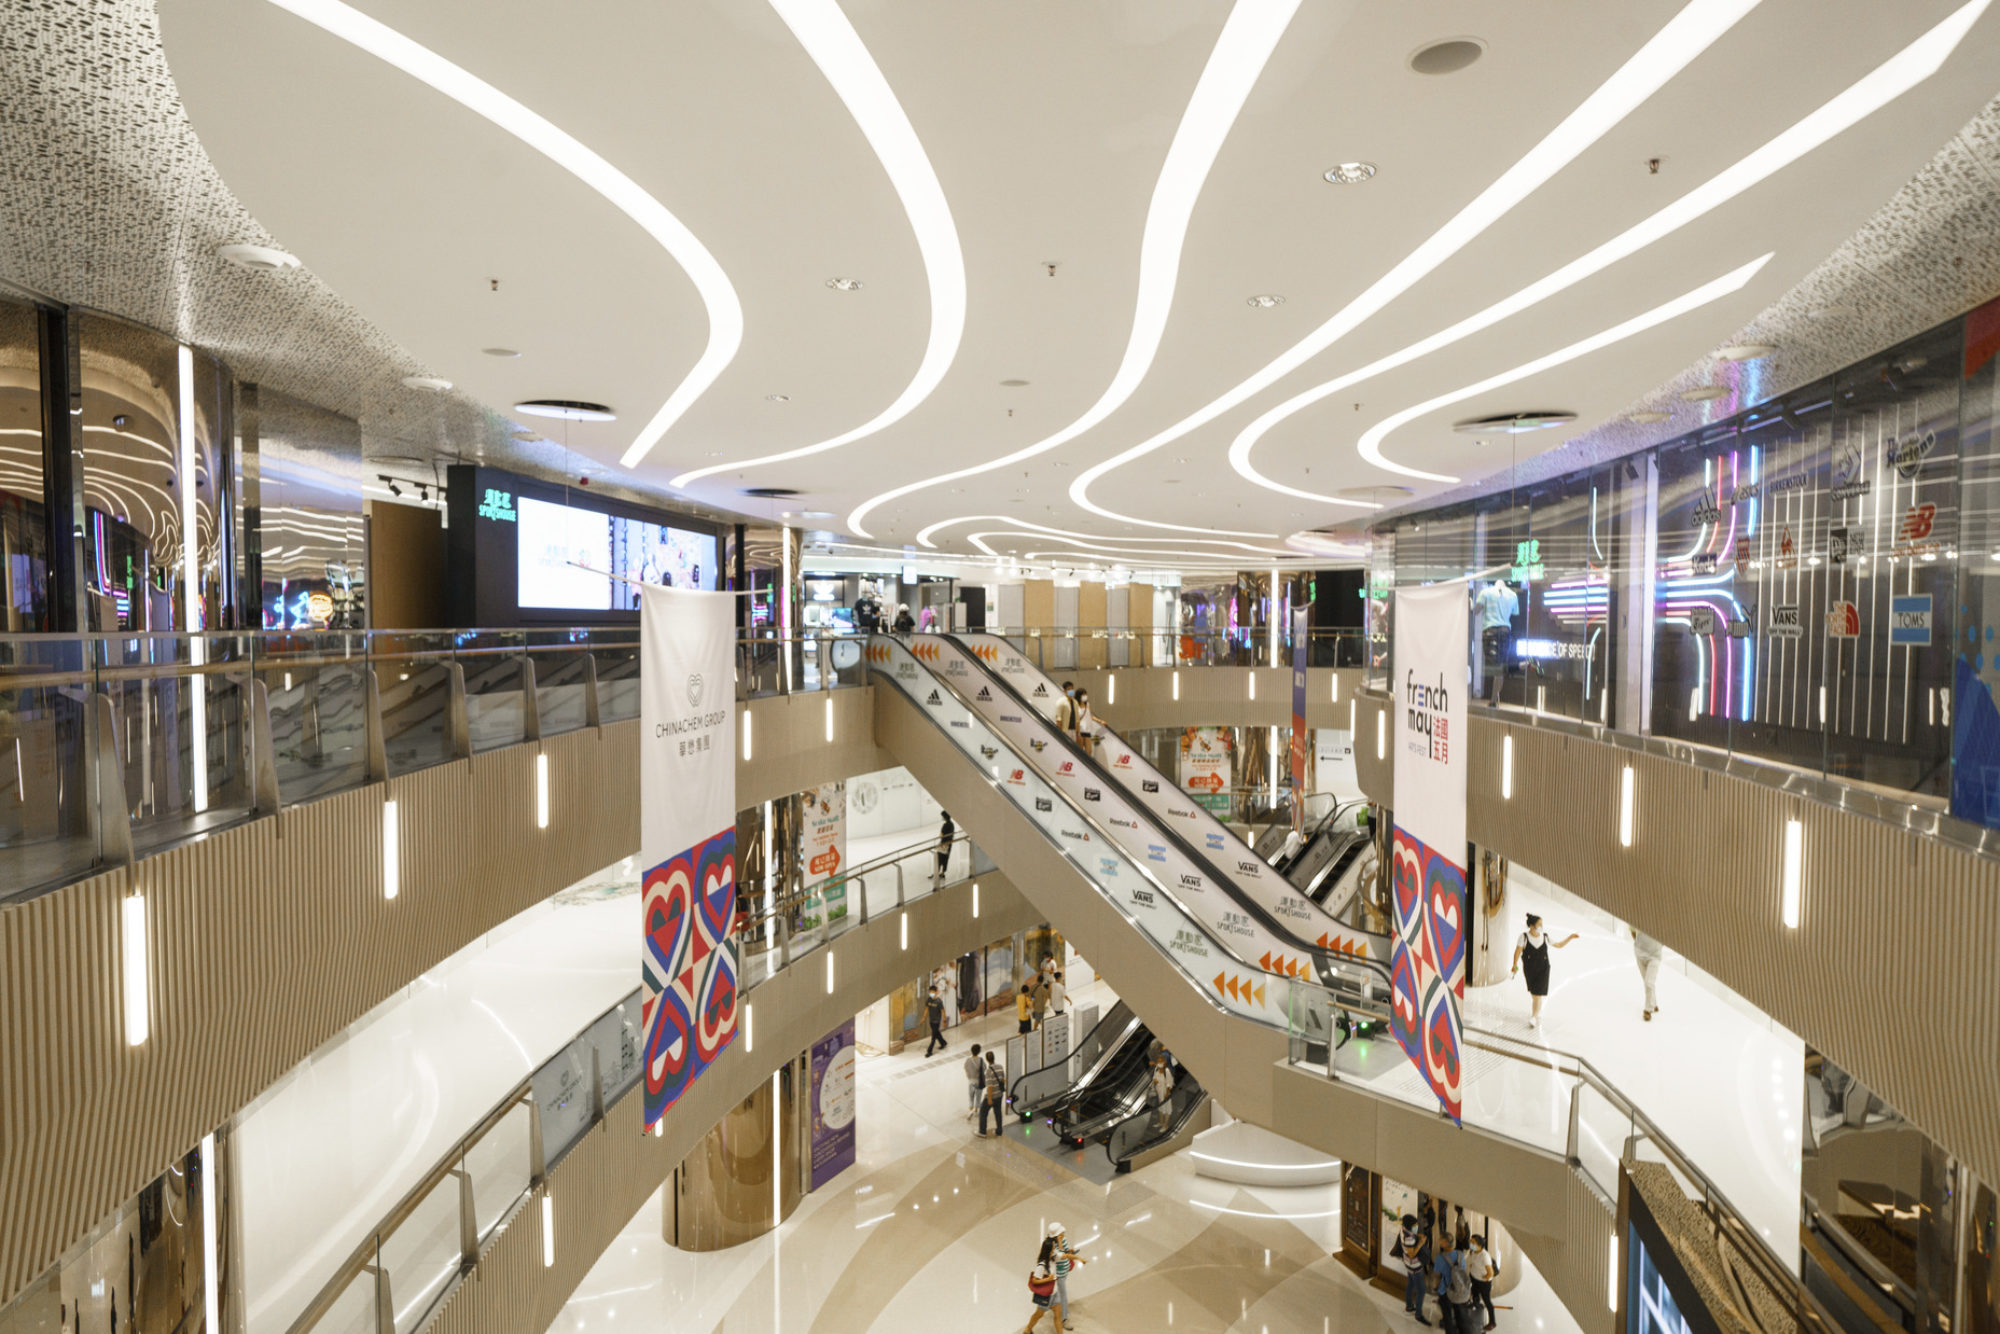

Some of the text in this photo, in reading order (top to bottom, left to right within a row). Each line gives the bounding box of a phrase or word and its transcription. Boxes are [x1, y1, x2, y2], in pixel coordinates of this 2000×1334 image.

[1691, 508, 1720, 527] adidas
[1772, 607, 1798, 625] VANS
[1898, 612, 1925, 629] TOMS
[656, 710, 726, 738] CHINACHEM GROUP
[1407, 708, 1432, 759] may
[1238, 861, 1259, 874] VANS
[1181, 874, 1202, 887] VANS
[1133, 890, 1154, 903] VANS
